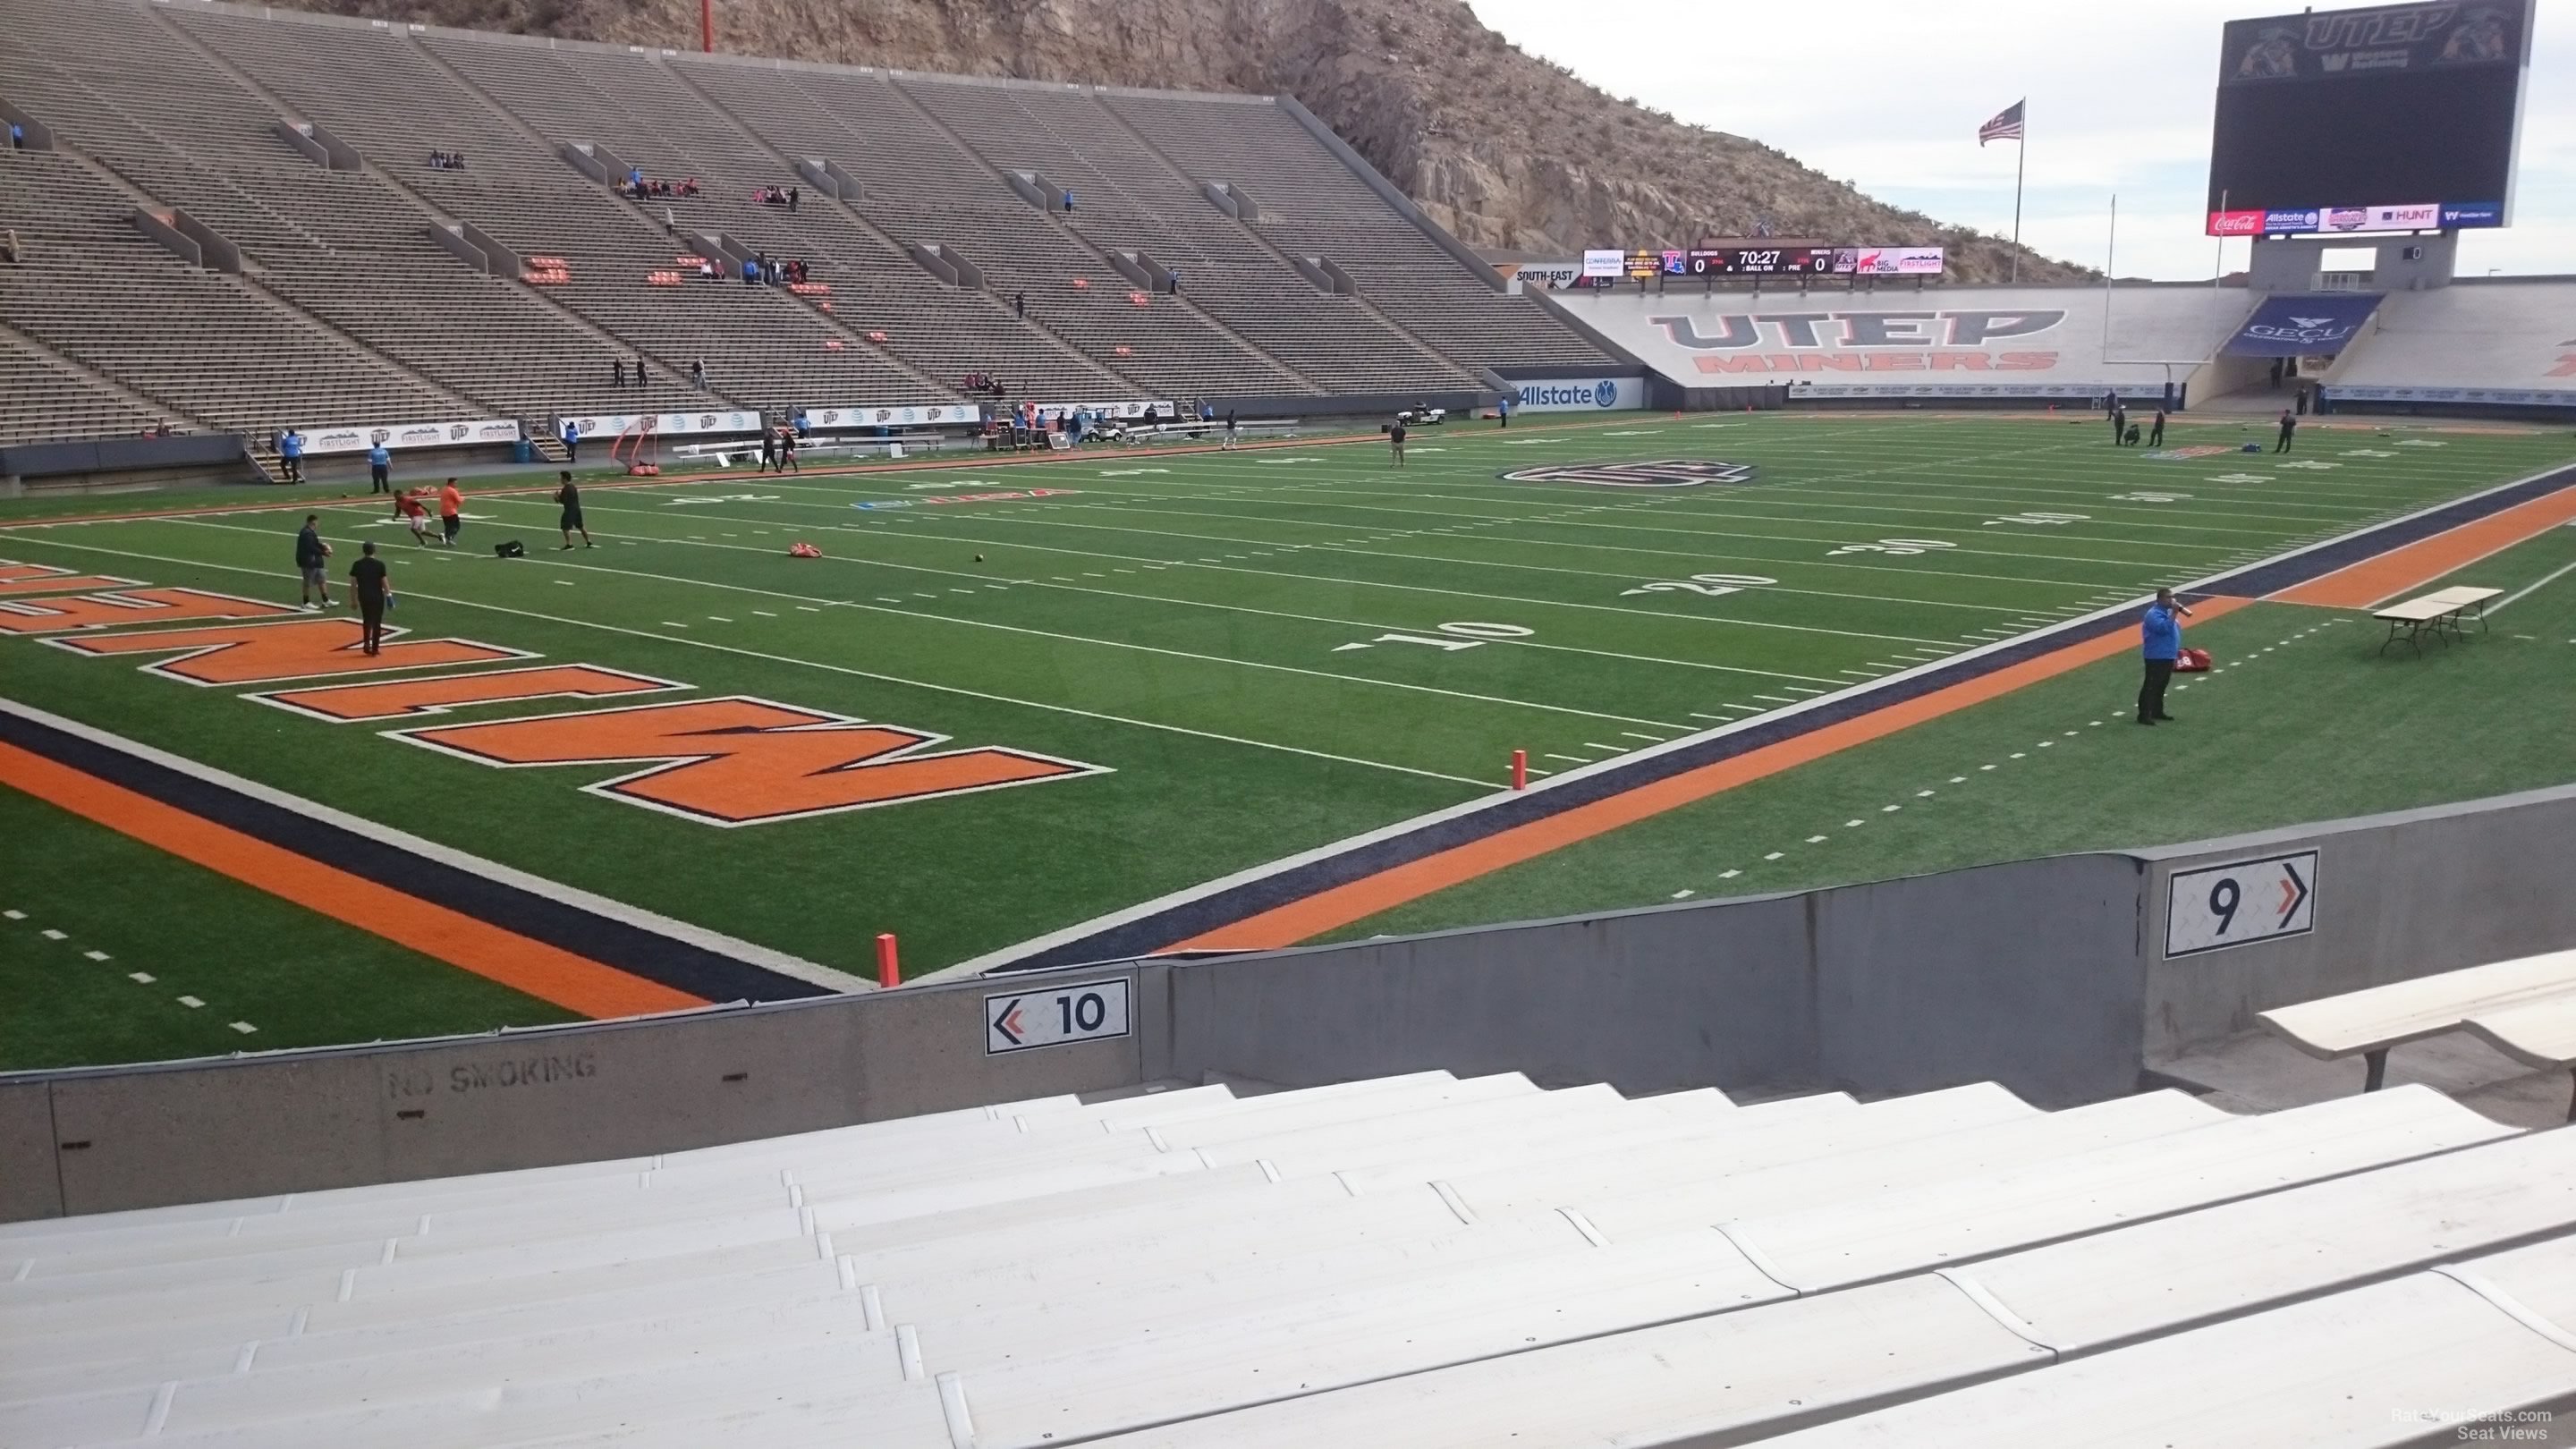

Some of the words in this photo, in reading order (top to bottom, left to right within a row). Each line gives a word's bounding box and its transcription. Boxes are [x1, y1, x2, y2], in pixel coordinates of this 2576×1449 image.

[2305, 4, 2459, 50] UTEP
[2266, 212, 2305, 223] Allstate
[2396, 210, 2433, 221] HUNT
[1739, 250, 1780, 265] 70:27
[1815, 258, 1826, 271] 0
[1900, 259, 1942, 267] FIRSTLIGHT
[1695, 259, 1705, 273] 0
[1517, 270, 1573, 281] SOUTH-EAST
[1646, 309, 2068, 350] UTEP
[2249, 325, 2350, 338] GECU
[1693, 352, 2059, 374] MINERS
[1520, 386, 1592, 405] Allstate
[823, 411, 839, 425] UTEP
[877, 410, 891, 423] UTEP
[928, 408, 941, 421] UTEP
[579, 419, 596, 435] UTEP
[700, 415, 716, 429] UTEP
[370, 429, 391, 445] UTEP
[402, 433, 441, 444] FIRSTLIGHT
[450, 425, 470, 441] UTEP
[479, 428, 516, 438] FIRSTLIGHT
[319, 438, 360, 448] FIRSTLIGHT
[1841, 538, 1958, 555] 30
[1641, 573, 1778, 597] 20
[1372, 622, 1535, 651] 10
[2209, 877, 2241, 936] 9
[1056, 992, 1106, 1035] 10
[450, 1055, 597, 1093] SMOKING
